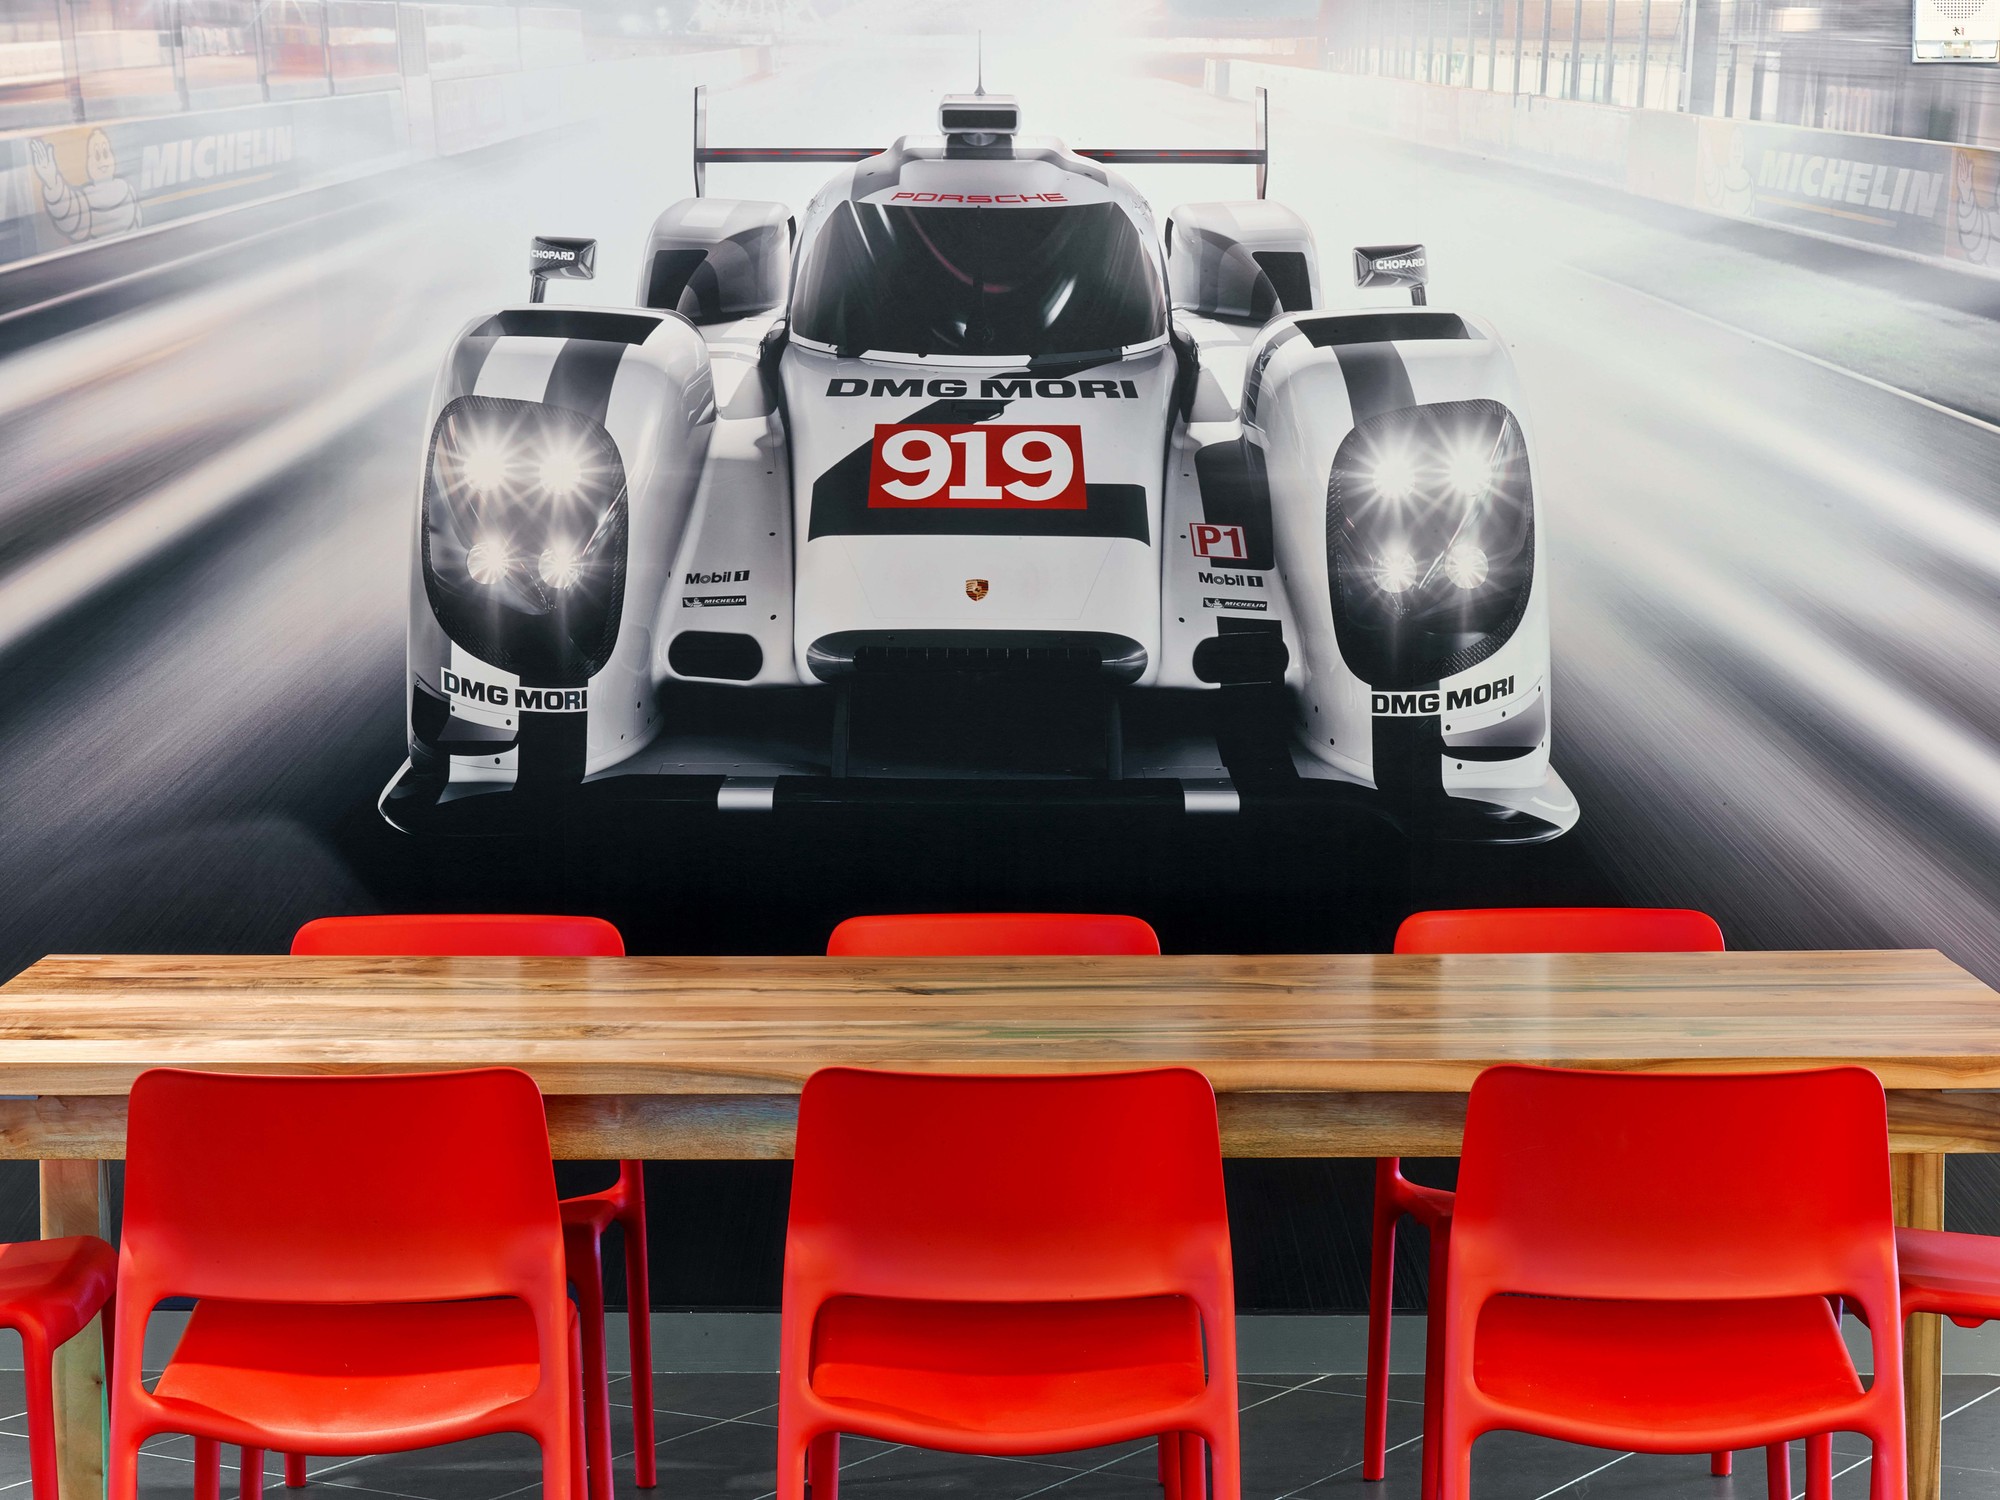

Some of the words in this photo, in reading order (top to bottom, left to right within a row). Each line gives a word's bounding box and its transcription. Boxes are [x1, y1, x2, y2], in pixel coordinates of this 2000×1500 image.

[141, 125, 293, 191] MICHELIN
[1757, 149, 1944, 218] MICHELIN
[891, 192, 1068, 204] PORSCHE
[531, 249, 575, 261] CHOPARD
[1375, 258, 1426, 270] CHOPARD
[825, 378, 968, 398] DMG
[980, 379, 1139, 399] MORI
[880, 429, 1074, 501] 919
[1196, 525, 1242, 558] P1
[685, 571, 732, 585] Mobil
[1198, 571, 1245, 586] Mobil
[1224, 601, 1267, 609] MICHELIN
[443, 670, 509, 706] DMG
[515, 688, 588, 710] MORI
[1371, 693, 1440, 714] DMG
[1446, 674, 1515, 711] MORI
